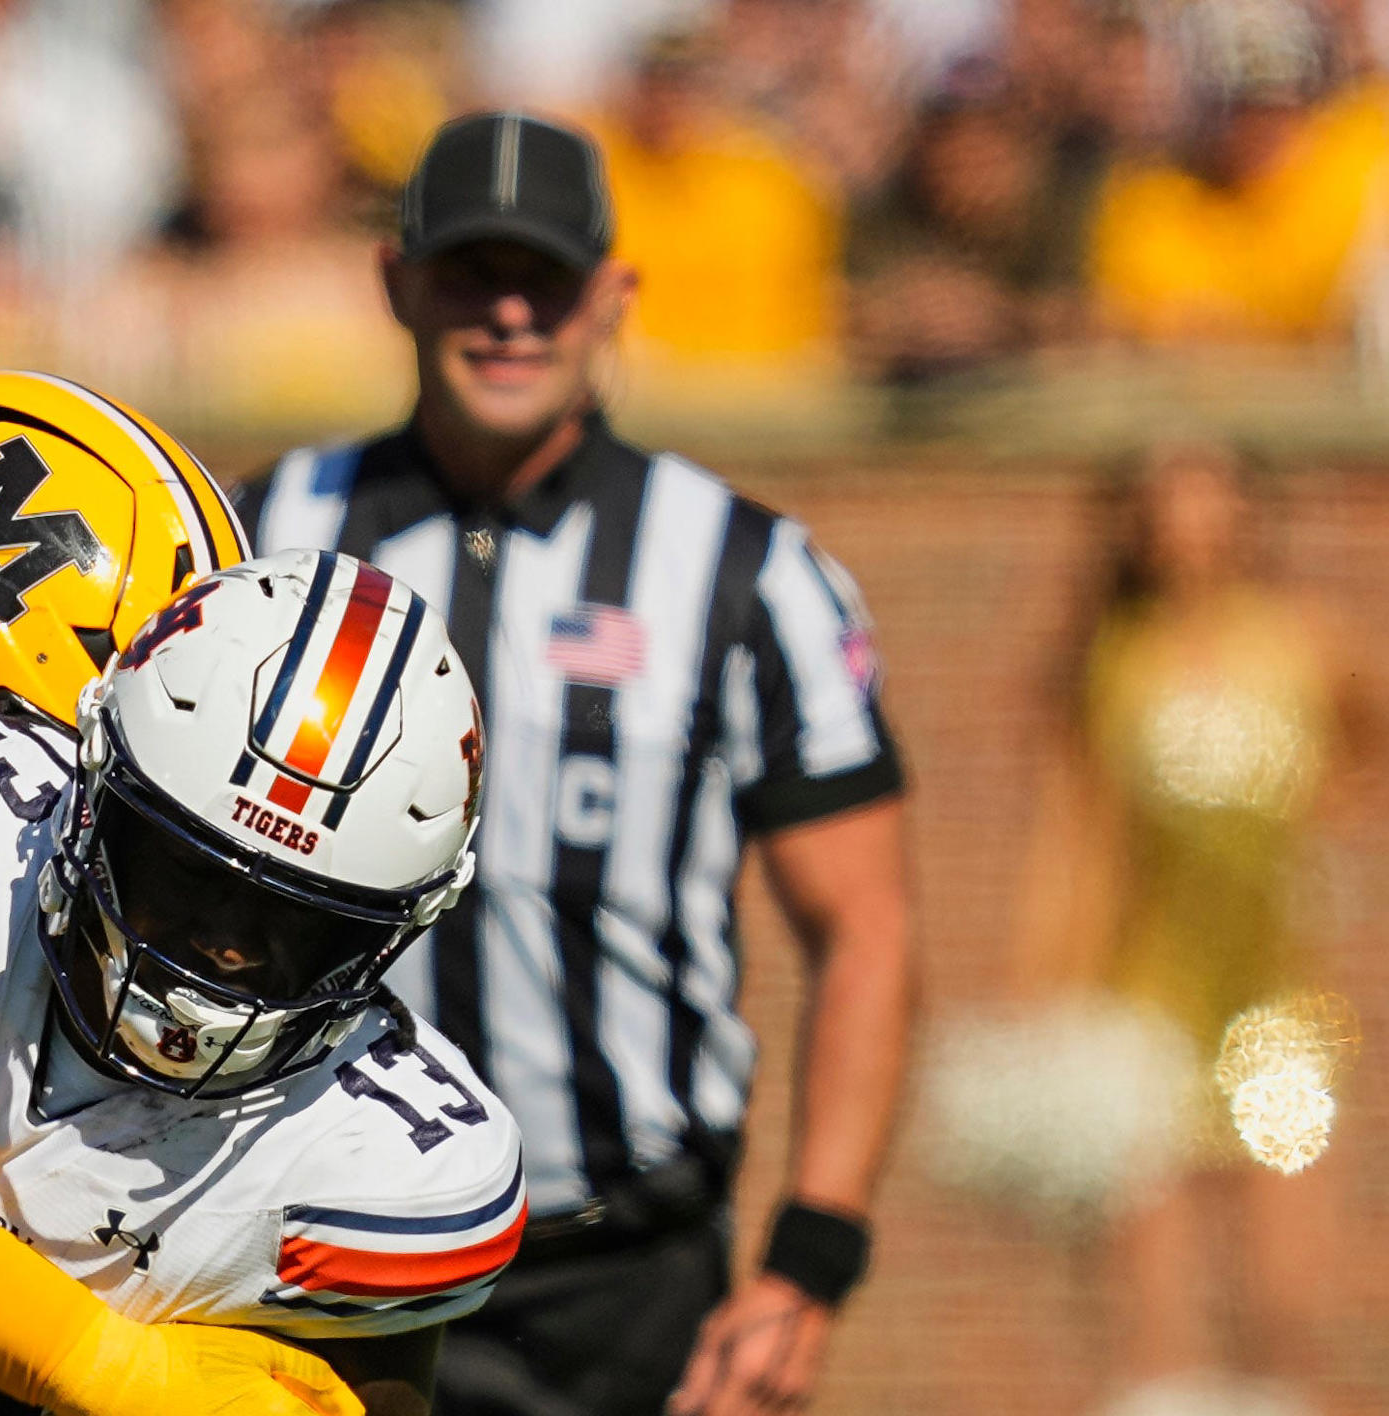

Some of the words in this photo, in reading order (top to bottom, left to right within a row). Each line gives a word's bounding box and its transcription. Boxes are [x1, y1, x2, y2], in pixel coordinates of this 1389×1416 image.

[231, 795, 319, 856] TIGERS
[556, 754, 616, 842] C
[333, 1028, 489, 1155] 13
